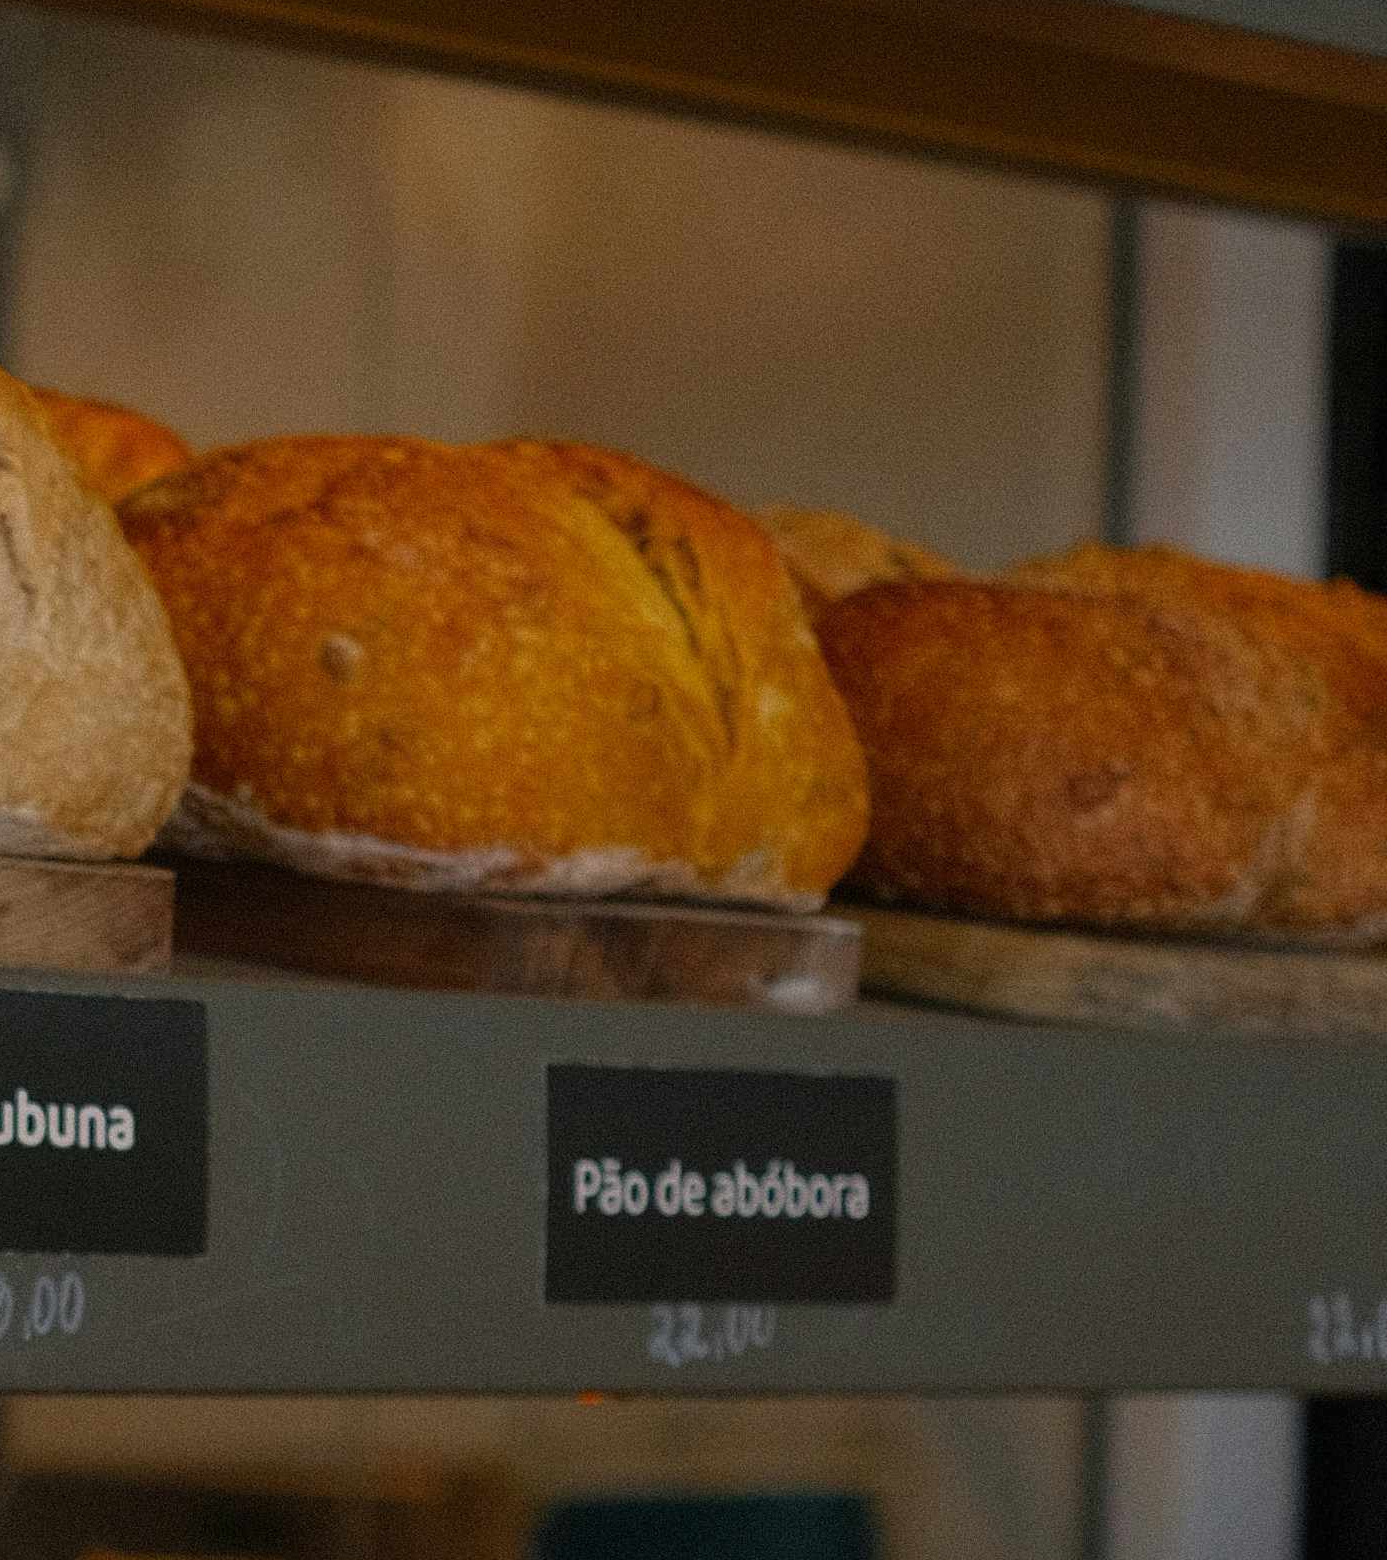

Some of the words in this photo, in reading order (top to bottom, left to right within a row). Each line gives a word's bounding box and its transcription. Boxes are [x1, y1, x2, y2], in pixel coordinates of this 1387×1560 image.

[573, 1157, 649, 1216] Pão
[654, 1158, 708, 1217] de
[712, 1156, 871, 1220] abóbora
